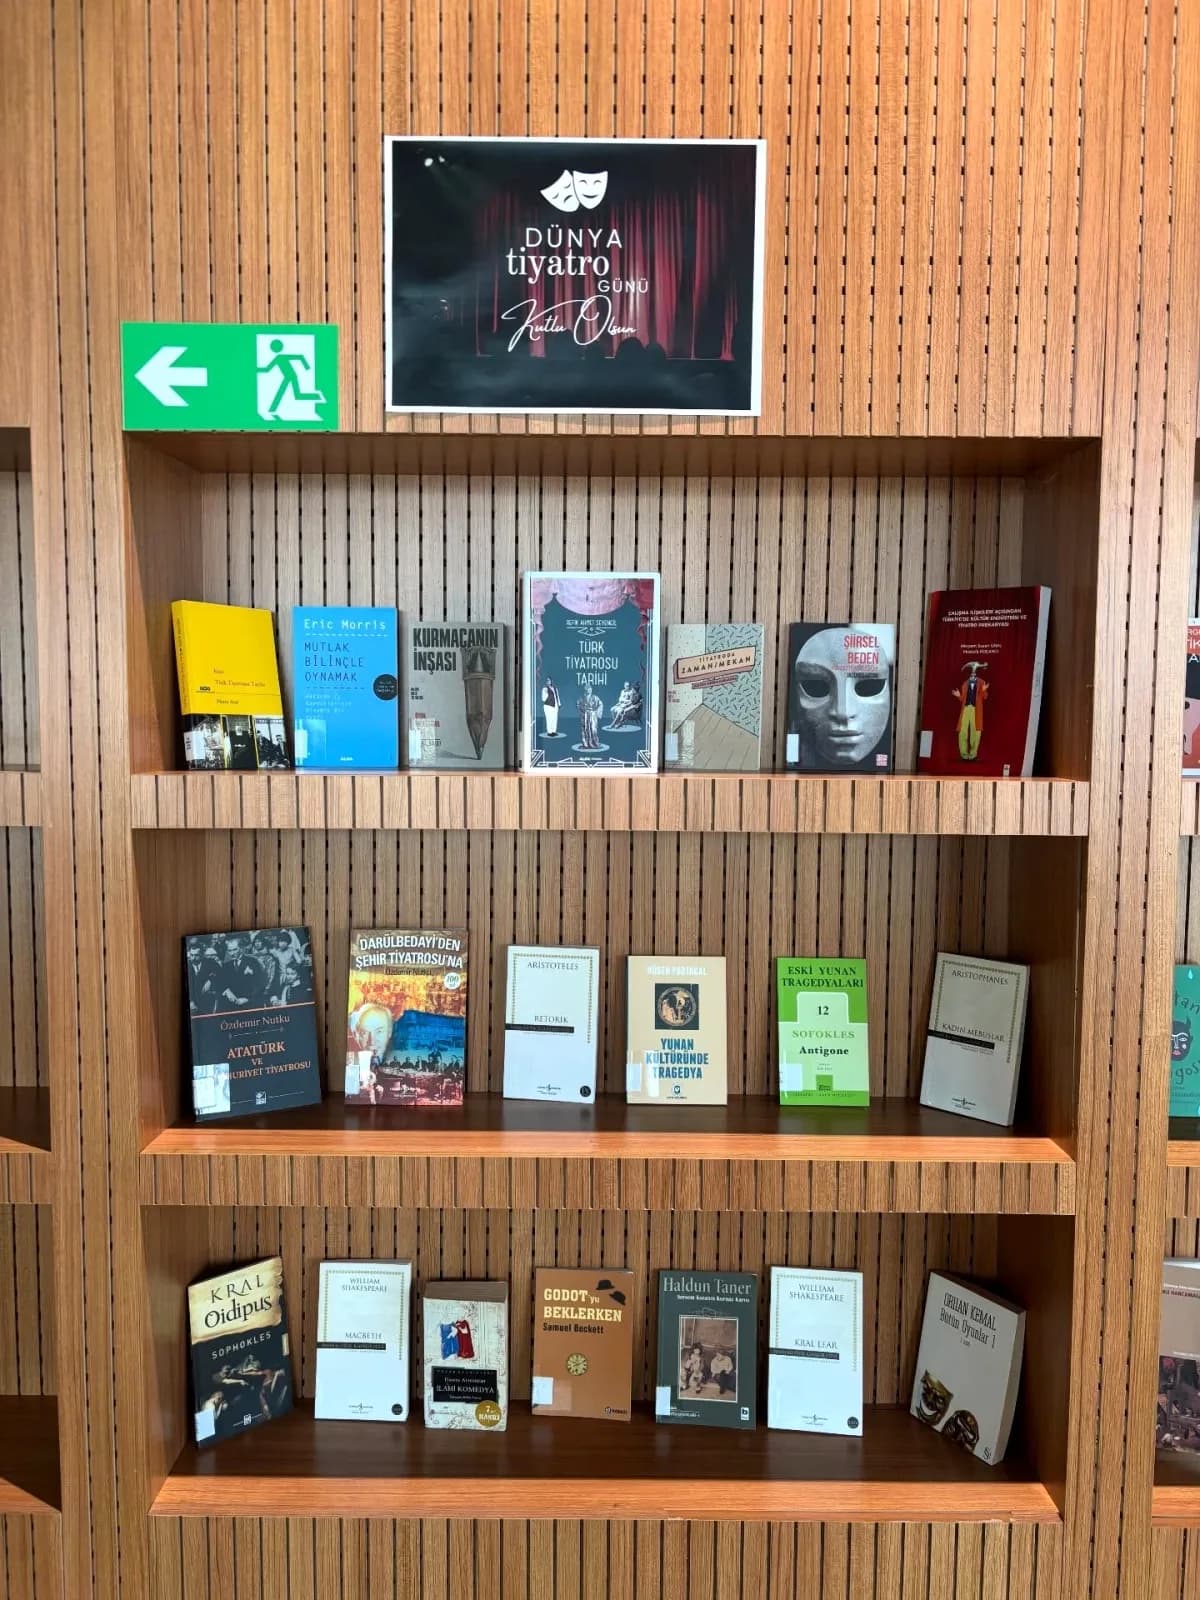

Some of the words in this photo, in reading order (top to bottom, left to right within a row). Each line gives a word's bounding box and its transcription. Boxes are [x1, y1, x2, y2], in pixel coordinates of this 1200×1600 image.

[526, 224, 623, 248] DÜNYA
[505, 246, 609, 283] tiyatro
[598, 278, 649, 293] GÜNÜ
[501, 298, 568, 352] Kutlu
[573, 295, 638, 346] Olsun
[304, 618, 334, 630] Eric
[341, 619, 386, 630] Morris
[413, 628, 498, 648] KURMACANIN
[304, 642, 350, 653] MUTLAK
[579, 638, 605, 654] TÜRK
[304, 654, 365, 669] BİLİNÇLE
[413, 650, 457, 675] İNŞASI
[565, 656, 618, 670] TİYATROSU
[681, 656, 751, 674] ZAMAN/MEKAN
[847, 652, 879, 664] BEDEN
[304, 671, 357, 682] OYNAMAK
[576, 671, 608, 686] TARİHİ
[360, 934, 461, 951] DARÜLBEDAYİ'DEN
[356, 952, 387, 970] ŞEHİR
[388, 950, 463, 968] TİYATROSU'NA
[787, 966, 813, 975] ESKİ
[819, 967, 857, 975] YUNAN
[782, 977, 864, 988] TRAGEDYALARI
[817, 1005, 830, 1016] 12
[220, 1017, 261, 1031] Özdemir
[262, 1014, 290, 1027] Nutku
[792, 1030, 856, 1039] SOFOKLES
[227, 1041, 285, 1059] ATATÜRK
[661, 1038, 694, 1050] YUNAN
[799, 1046, 850, 1057] Antigone
[251, 1057, 263, 1066] VE
[646, 1050, 709, 1065] KÜLTÜRÜNDE
[266, 1061, 311, 1075] TİYATROSU
[653, 1067, 703, 1079] TRAGEDYA
[211, 1274, 264, 1303] KRAL
[663, 1276, 710, 1293] Haldun
[713, 1278, 752, 1295] Taner
[799, 1283, 835, 1293] WILLIAM
[789, 1291, 845, 1302] SHAKESPEARE
[204, 1295, 272, 1329] Oidipus
[543, 1306, 622, 1322] BEKLERKEN
[944, 1292, 969, 1316] ORHAN
[970, 1305, 996, 1331] KEMAL
[543, 1323, 572, 1332] Samuel
[574, 1324, 604, 1334] Beckett
[940, 1307, 960, 1330] Bütün
[961, 1318, 989, 1345] Oyunlar
[211, 1331, 272, 1360] SOPHOKLES
[457, 1385, 494, 1394] KOMEDYA
